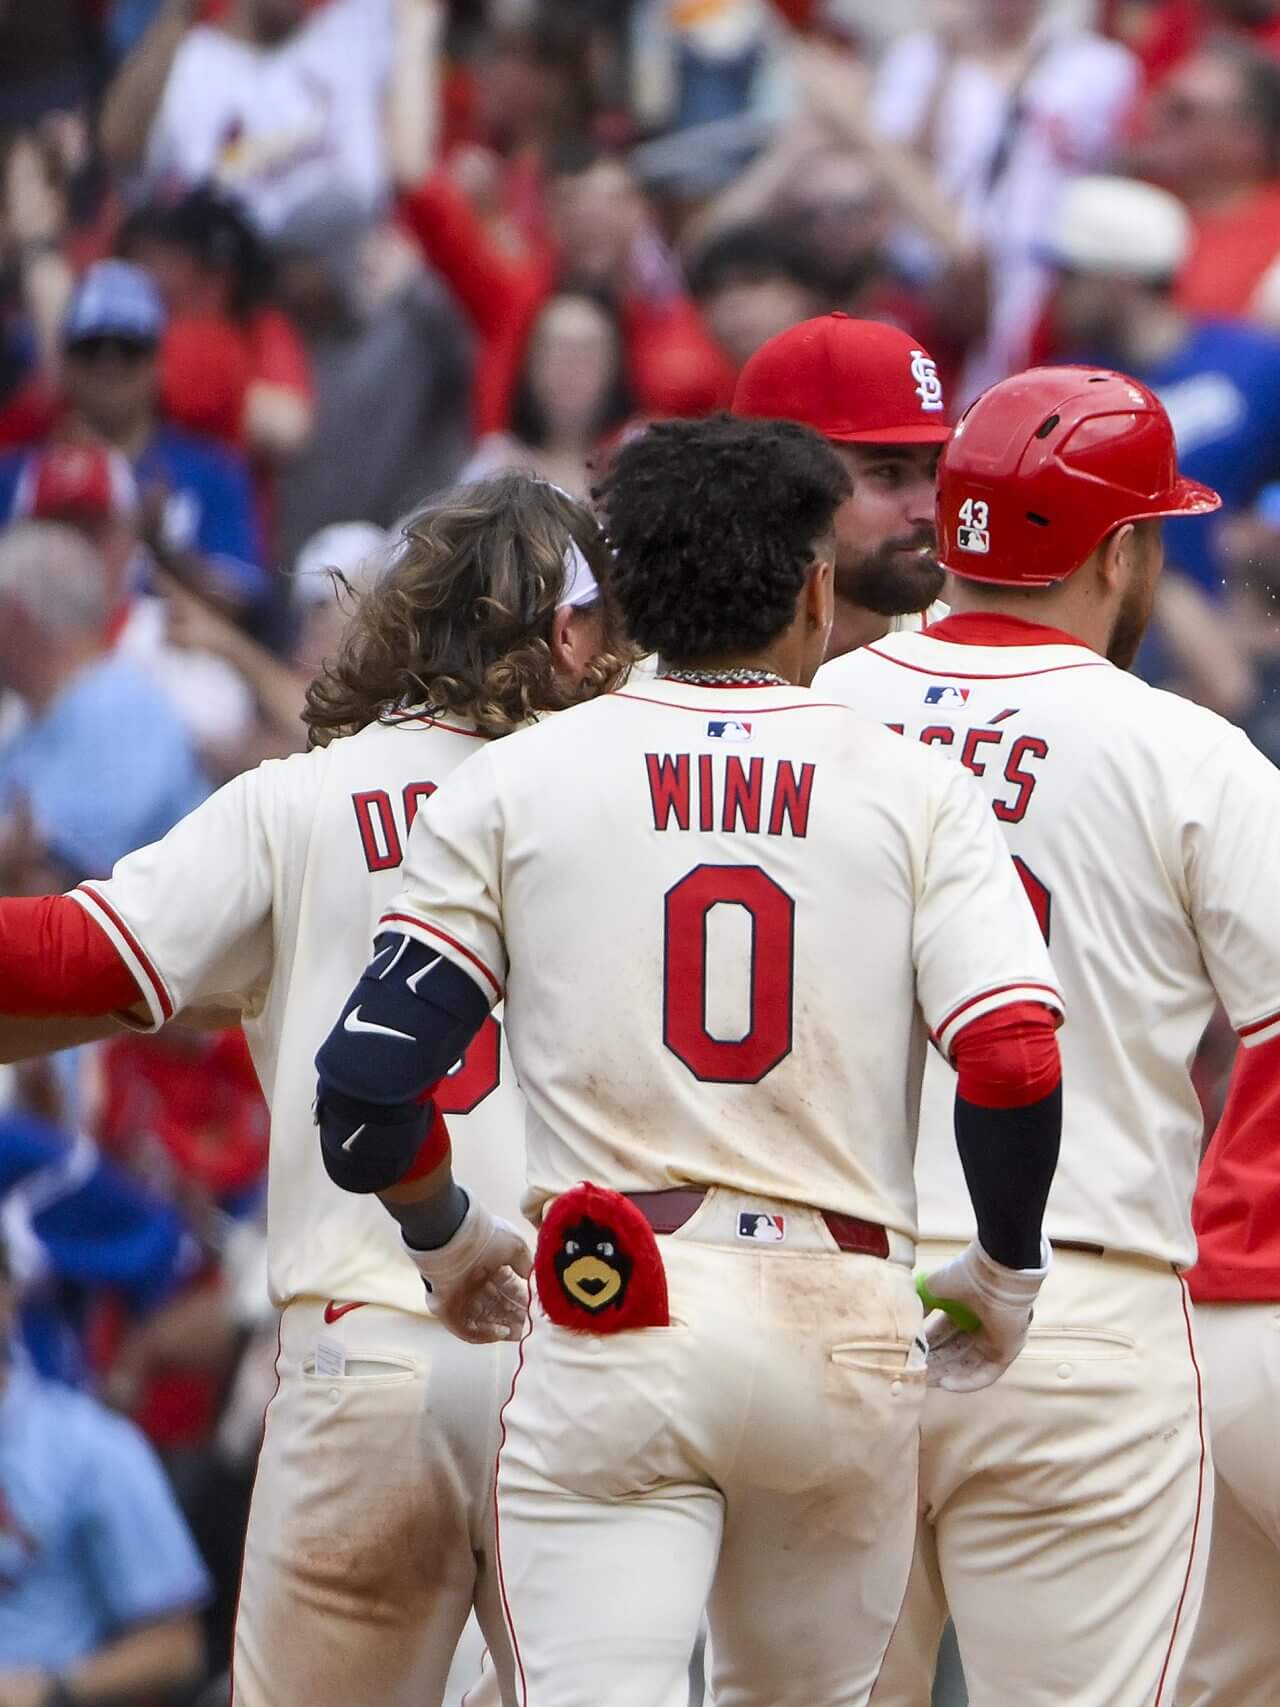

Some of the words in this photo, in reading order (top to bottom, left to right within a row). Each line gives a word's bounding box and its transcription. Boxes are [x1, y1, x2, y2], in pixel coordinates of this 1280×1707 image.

[958, 497, 989, 531] 43
[644, 752, 816, 838] WINN
[663, 863, 795, 1085] 0
